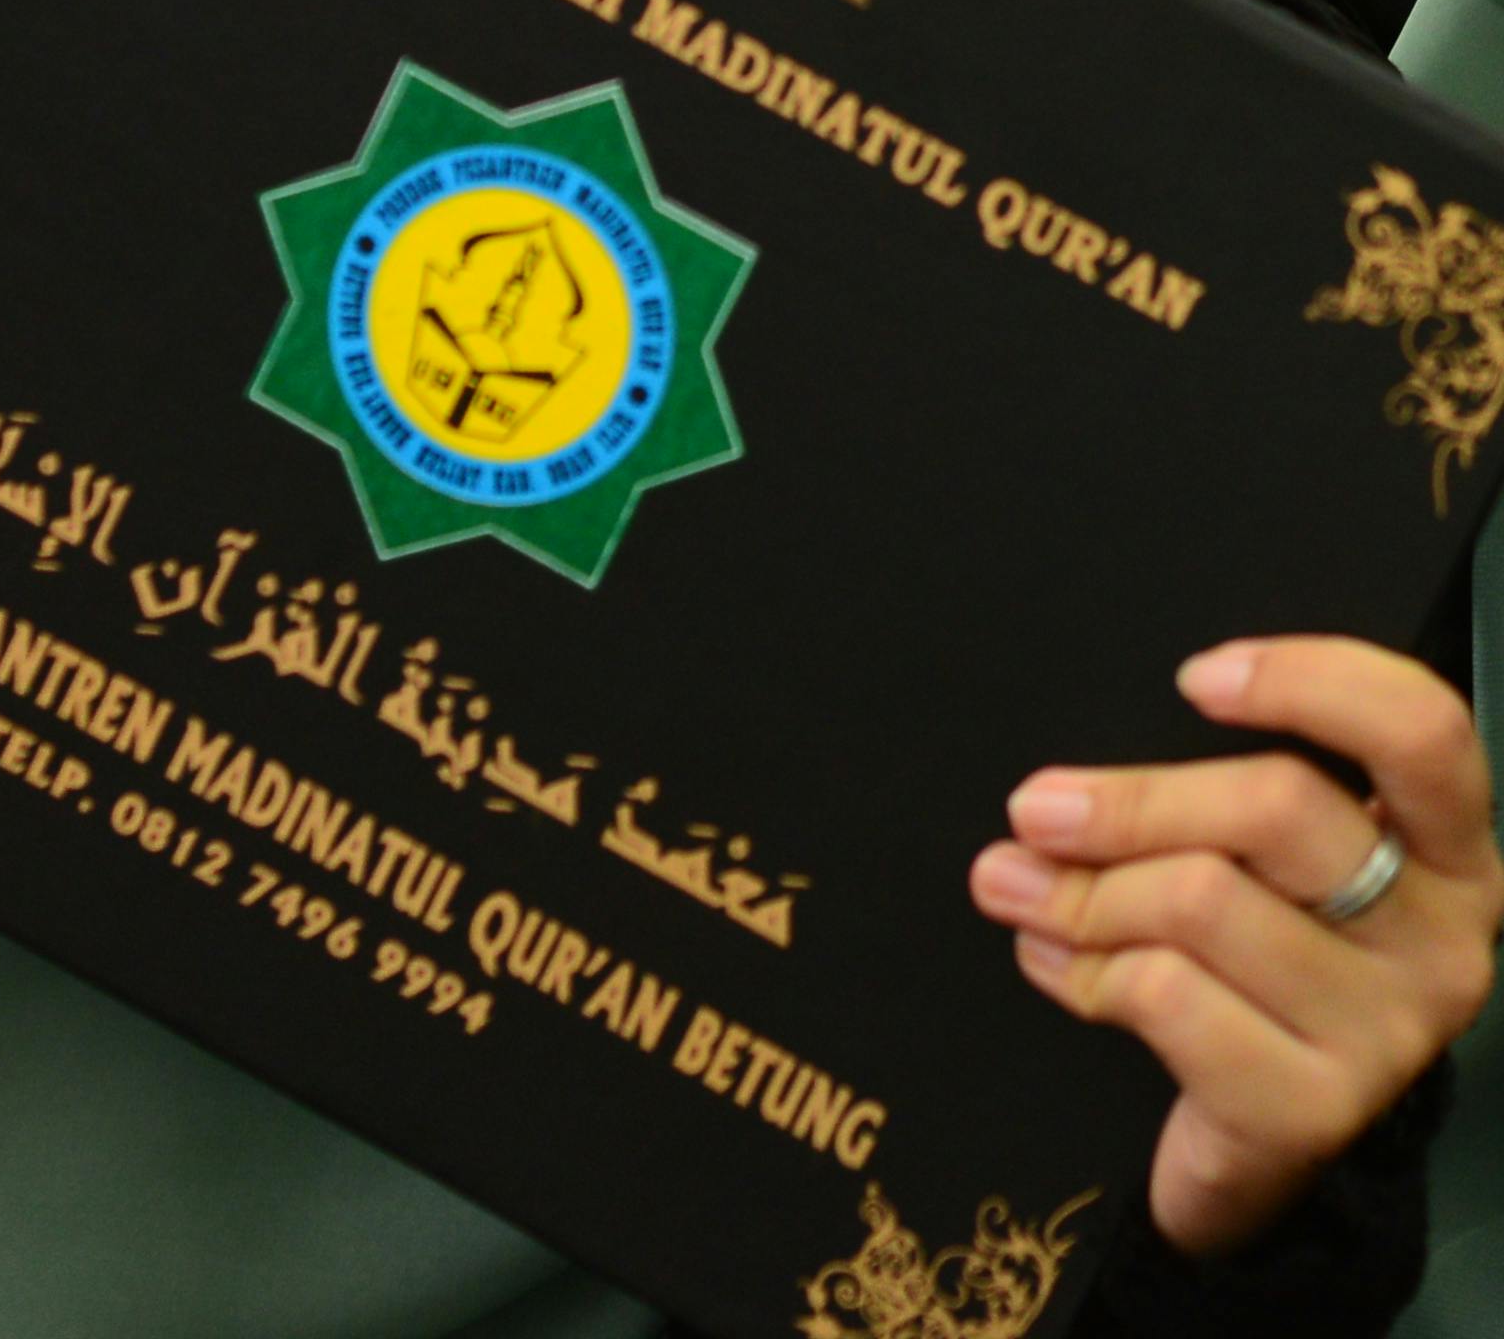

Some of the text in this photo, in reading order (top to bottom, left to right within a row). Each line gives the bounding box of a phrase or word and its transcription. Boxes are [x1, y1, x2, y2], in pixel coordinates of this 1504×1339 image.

[977, 179, 1204, 330] QUR'AN
[112, 793, 231, 886] 0812
[241, 865, 361, 959] 7496
[374, 939, 493, 1035] 9994
[167, 717, 464, 932] MADINATUL
[469, 892, 680, 1051] QUR'AN
[673, 1006, 886, 1168] BETUNG
